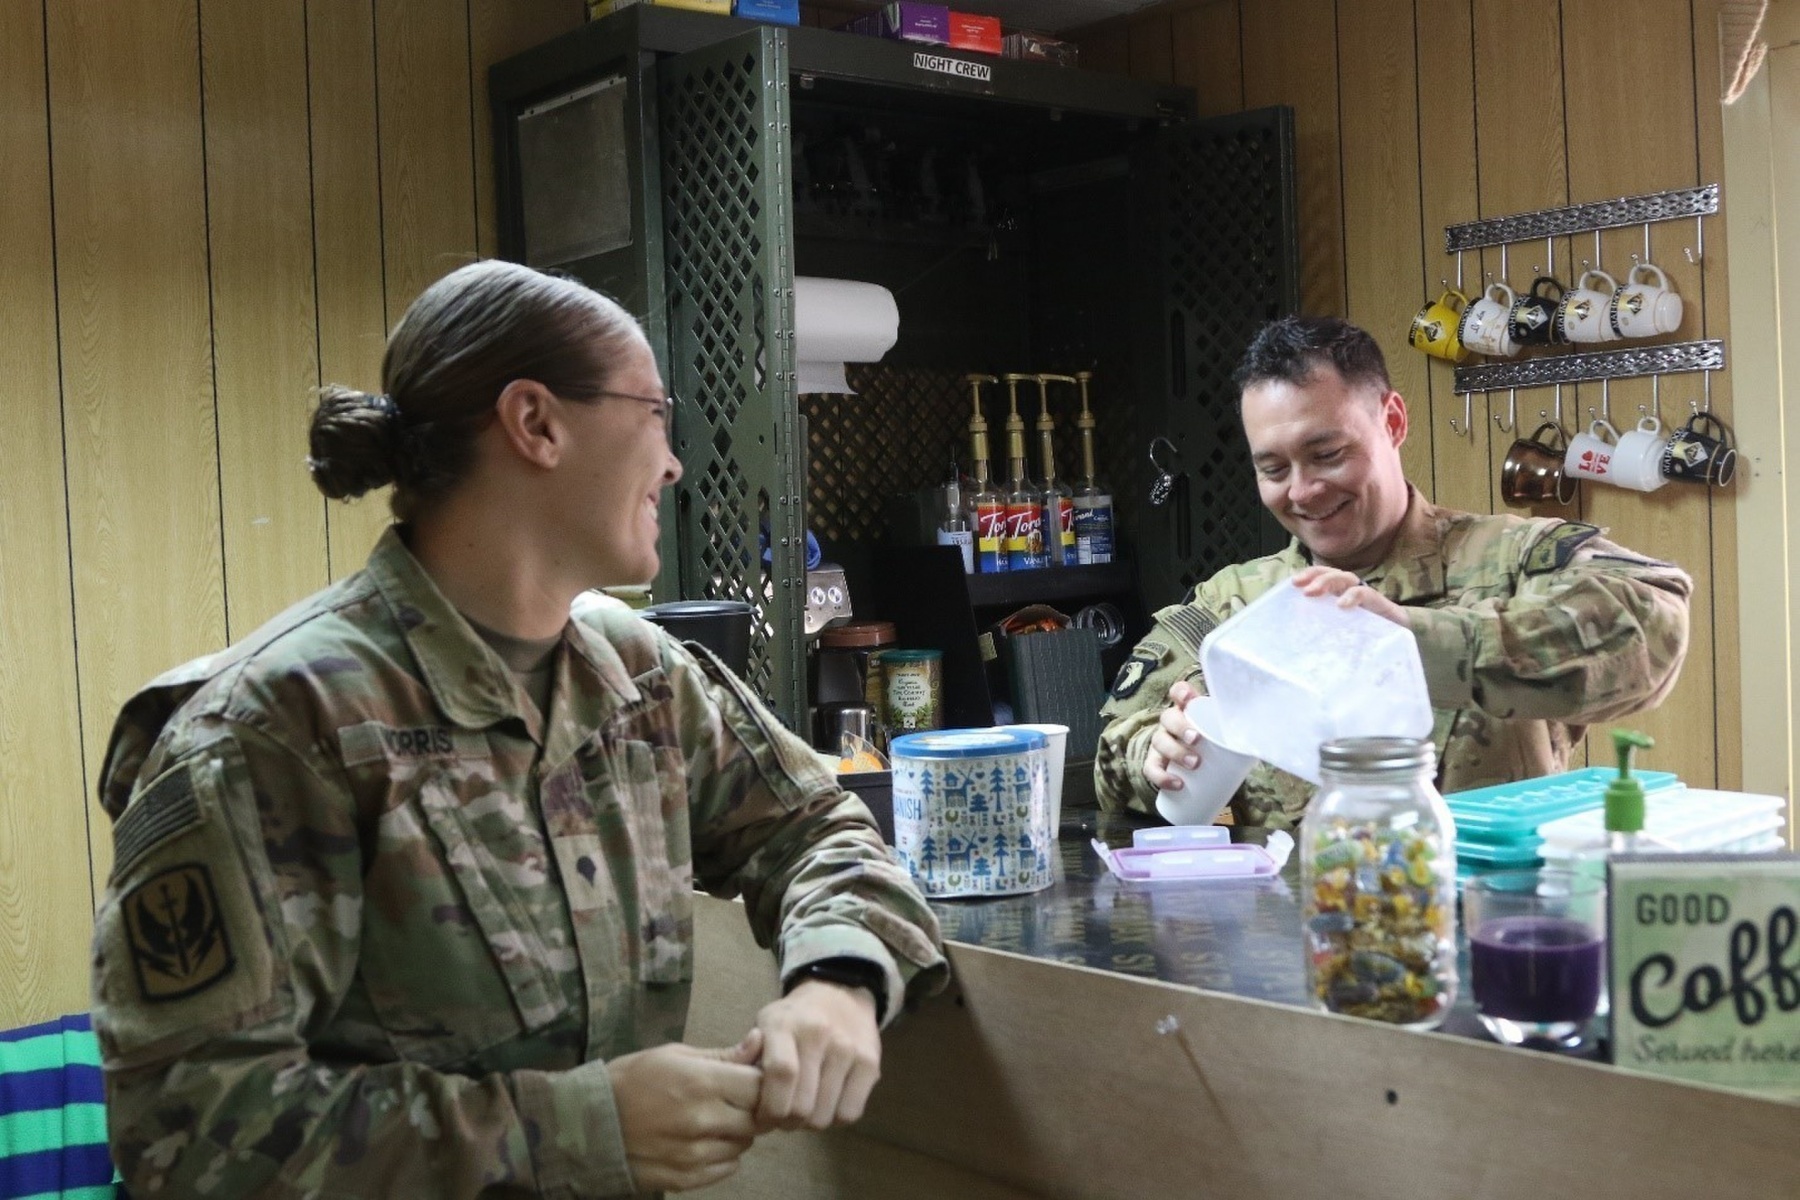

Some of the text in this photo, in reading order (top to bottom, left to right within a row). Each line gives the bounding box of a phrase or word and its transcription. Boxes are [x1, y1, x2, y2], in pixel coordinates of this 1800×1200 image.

[915, 53, 989, 79] NIGHT CREW
[1636, 893, 1730, 927] GOOD
[1633, 1033, 1737, 1065] Served
